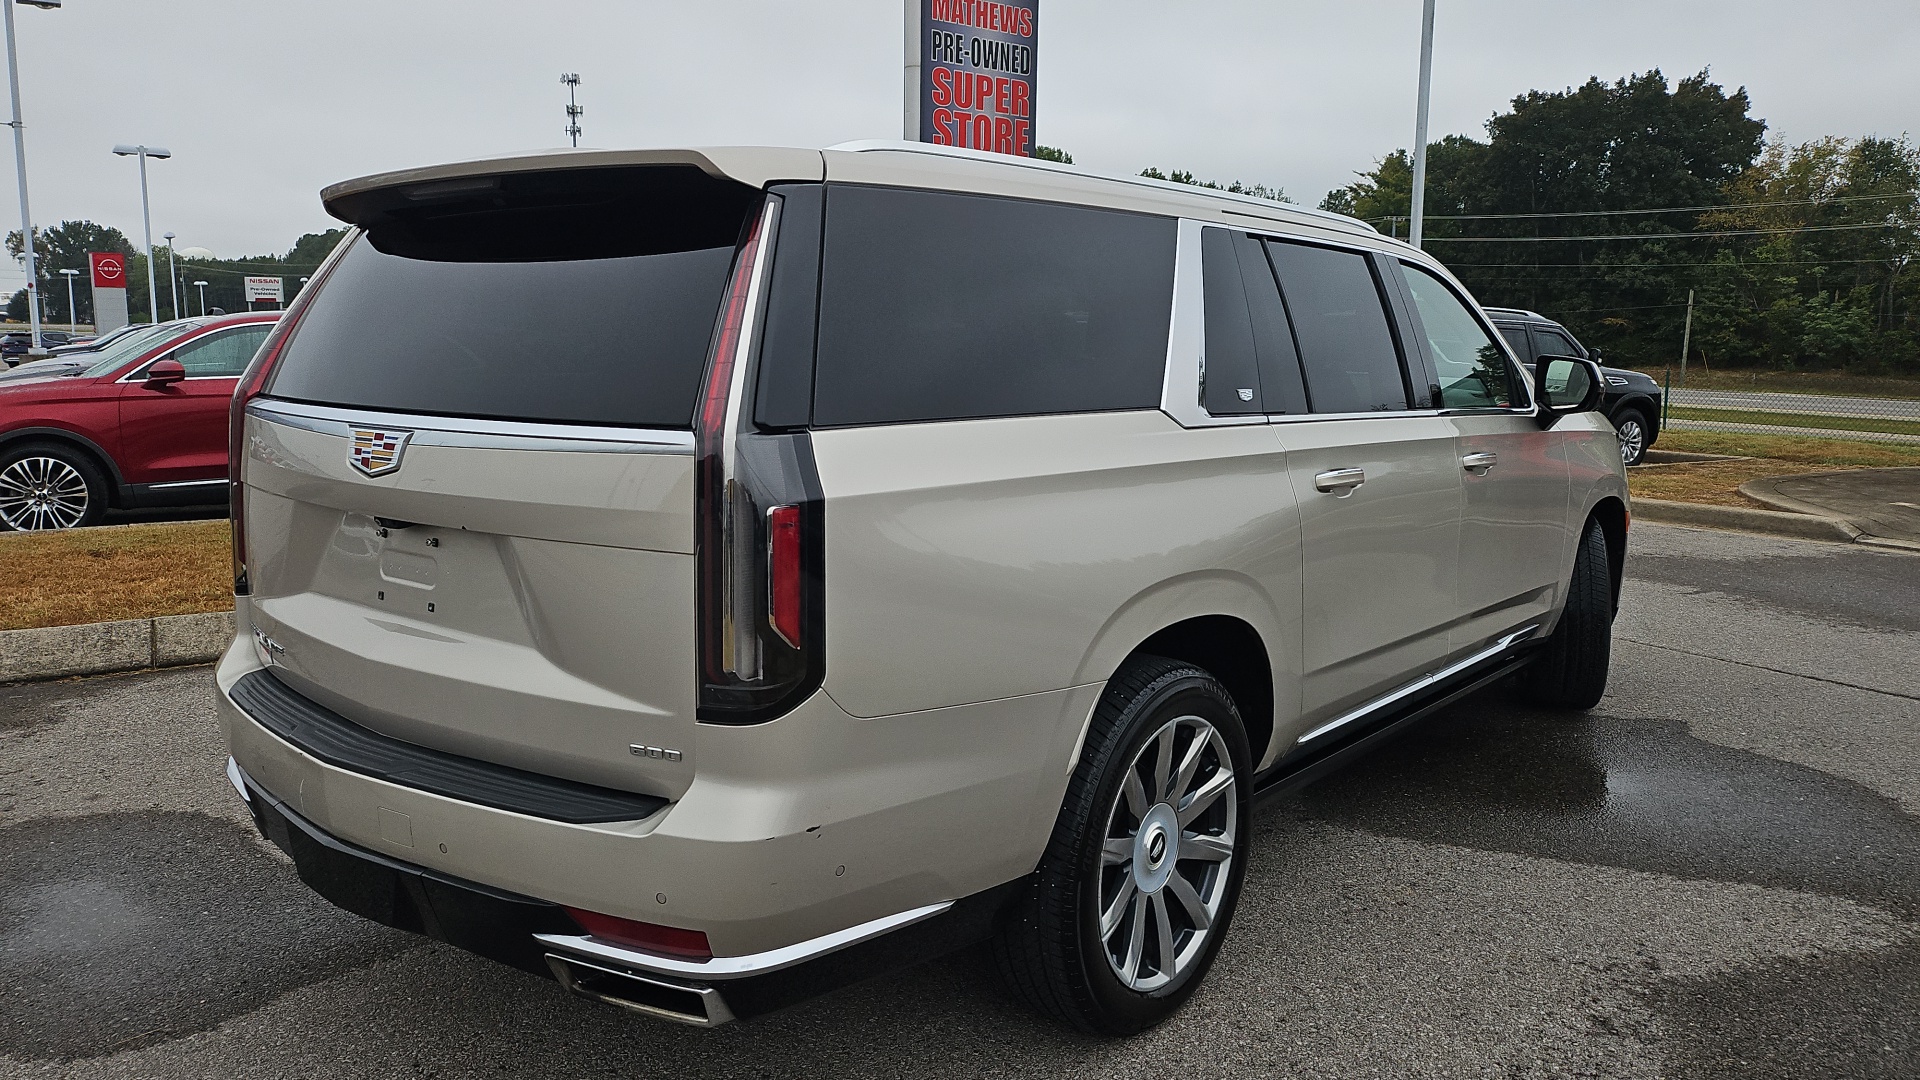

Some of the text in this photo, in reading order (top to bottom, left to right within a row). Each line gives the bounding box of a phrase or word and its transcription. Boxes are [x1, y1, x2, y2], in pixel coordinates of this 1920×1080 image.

[931, 0, 1033, 37] MATHEWS
[931, 29, 1031, 76] PRE-OWNED
[932, 66, 1030, 117] SUPER
[933, 107, 1030, 158] STORE
[629, 743, 683, 762] 600
